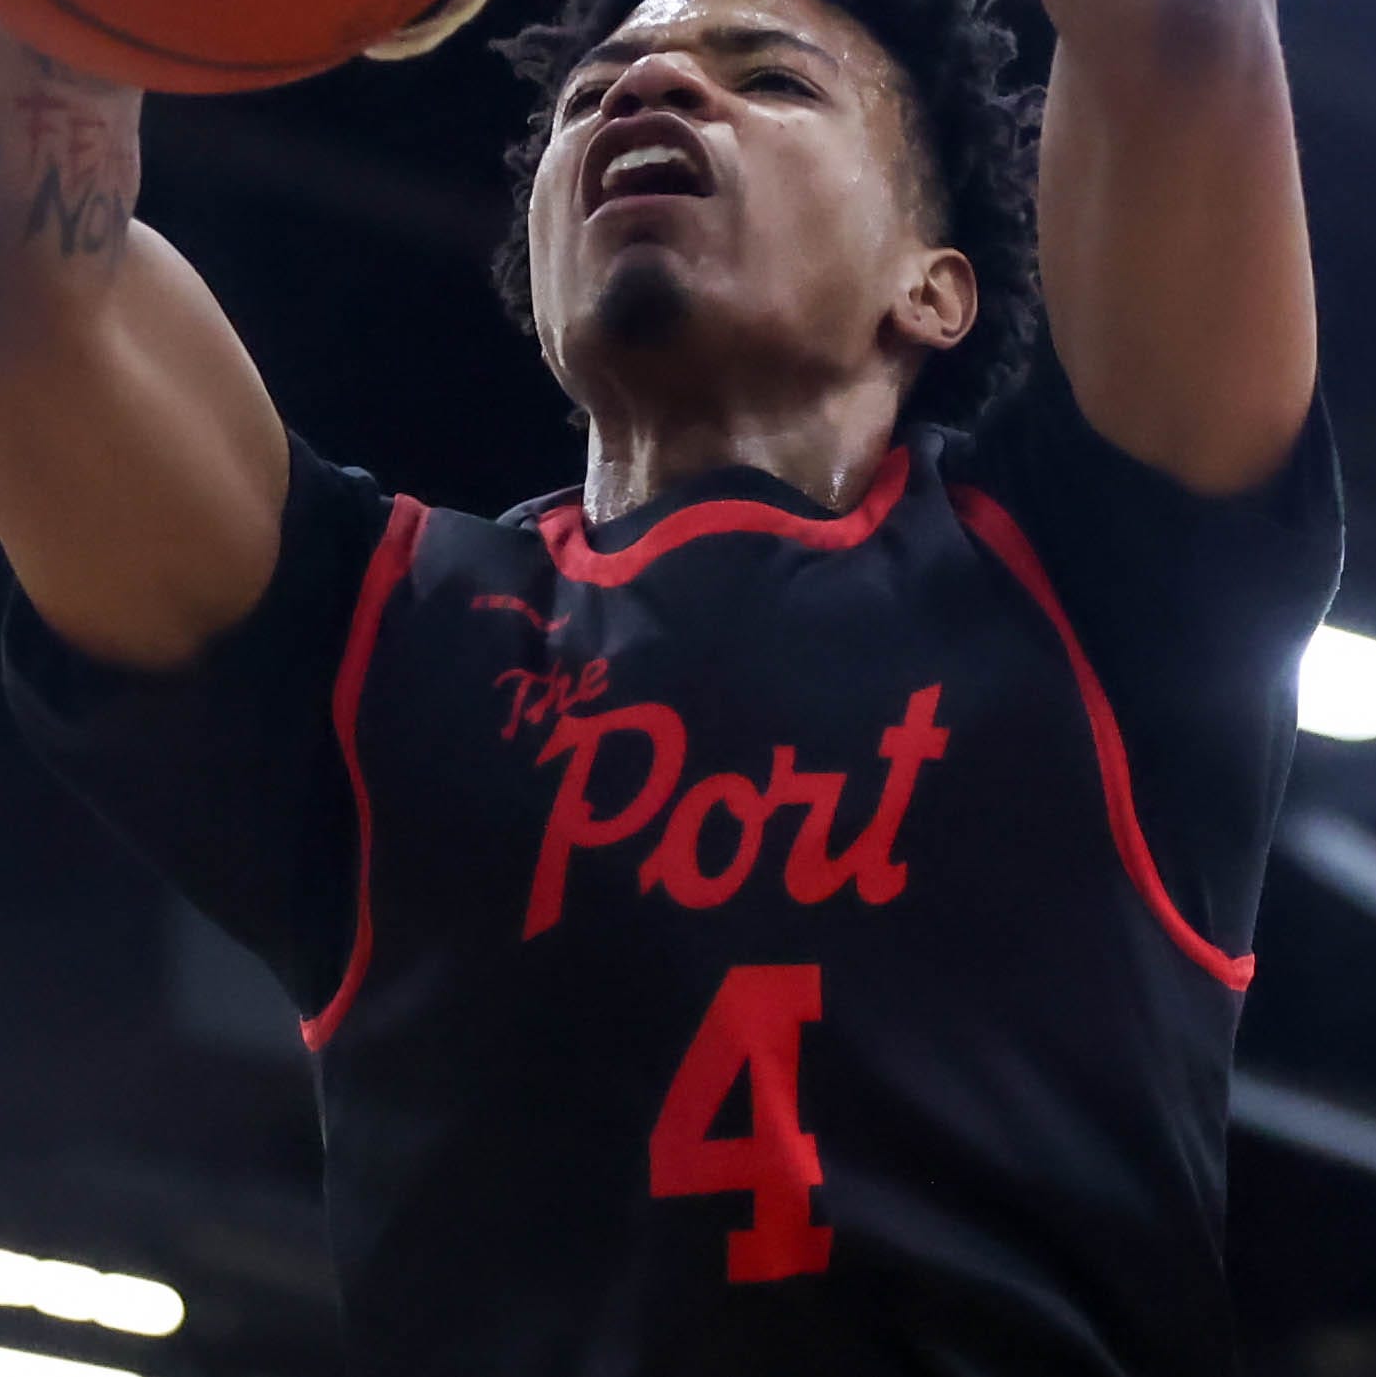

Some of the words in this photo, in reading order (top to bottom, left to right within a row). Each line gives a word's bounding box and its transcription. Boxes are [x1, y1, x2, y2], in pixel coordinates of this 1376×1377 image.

[492, 656, 611, 741] The
[522, 681, 951, 942] Port
[648, 963, 834, 1285] 4
